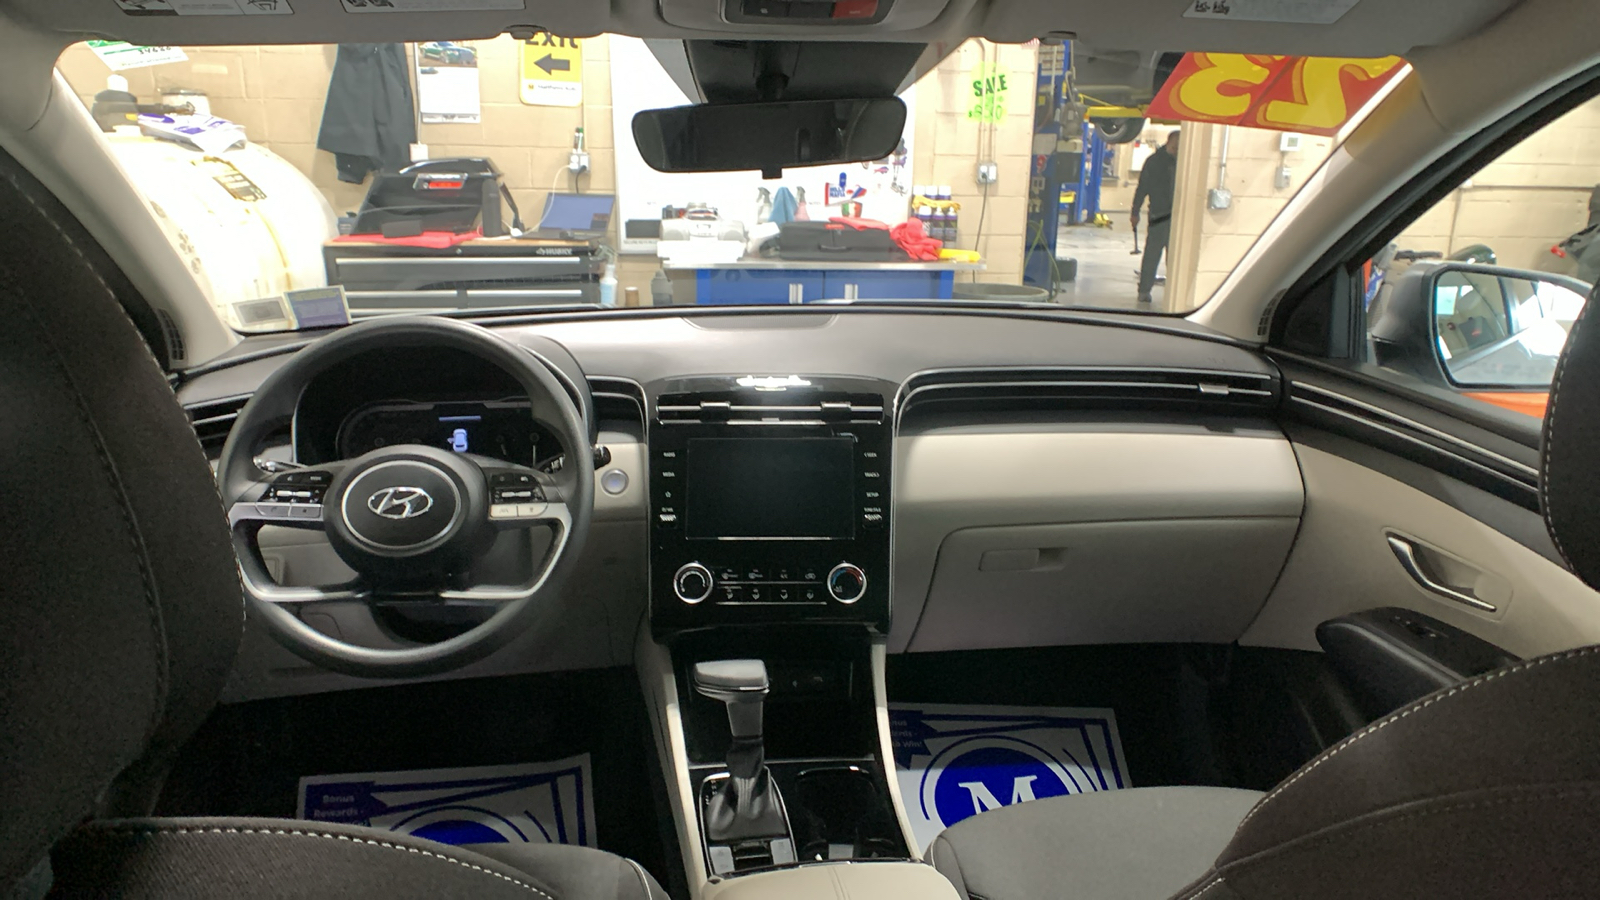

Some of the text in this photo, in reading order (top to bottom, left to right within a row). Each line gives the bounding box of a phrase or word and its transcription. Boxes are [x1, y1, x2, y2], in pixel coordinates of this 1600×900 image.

[973, 74, 1008, 97] SALE
[545, 248, 573, 256] HUSKY
[322, 794, 355, 804] Bonus
[958, 775, 1038, 815] M
